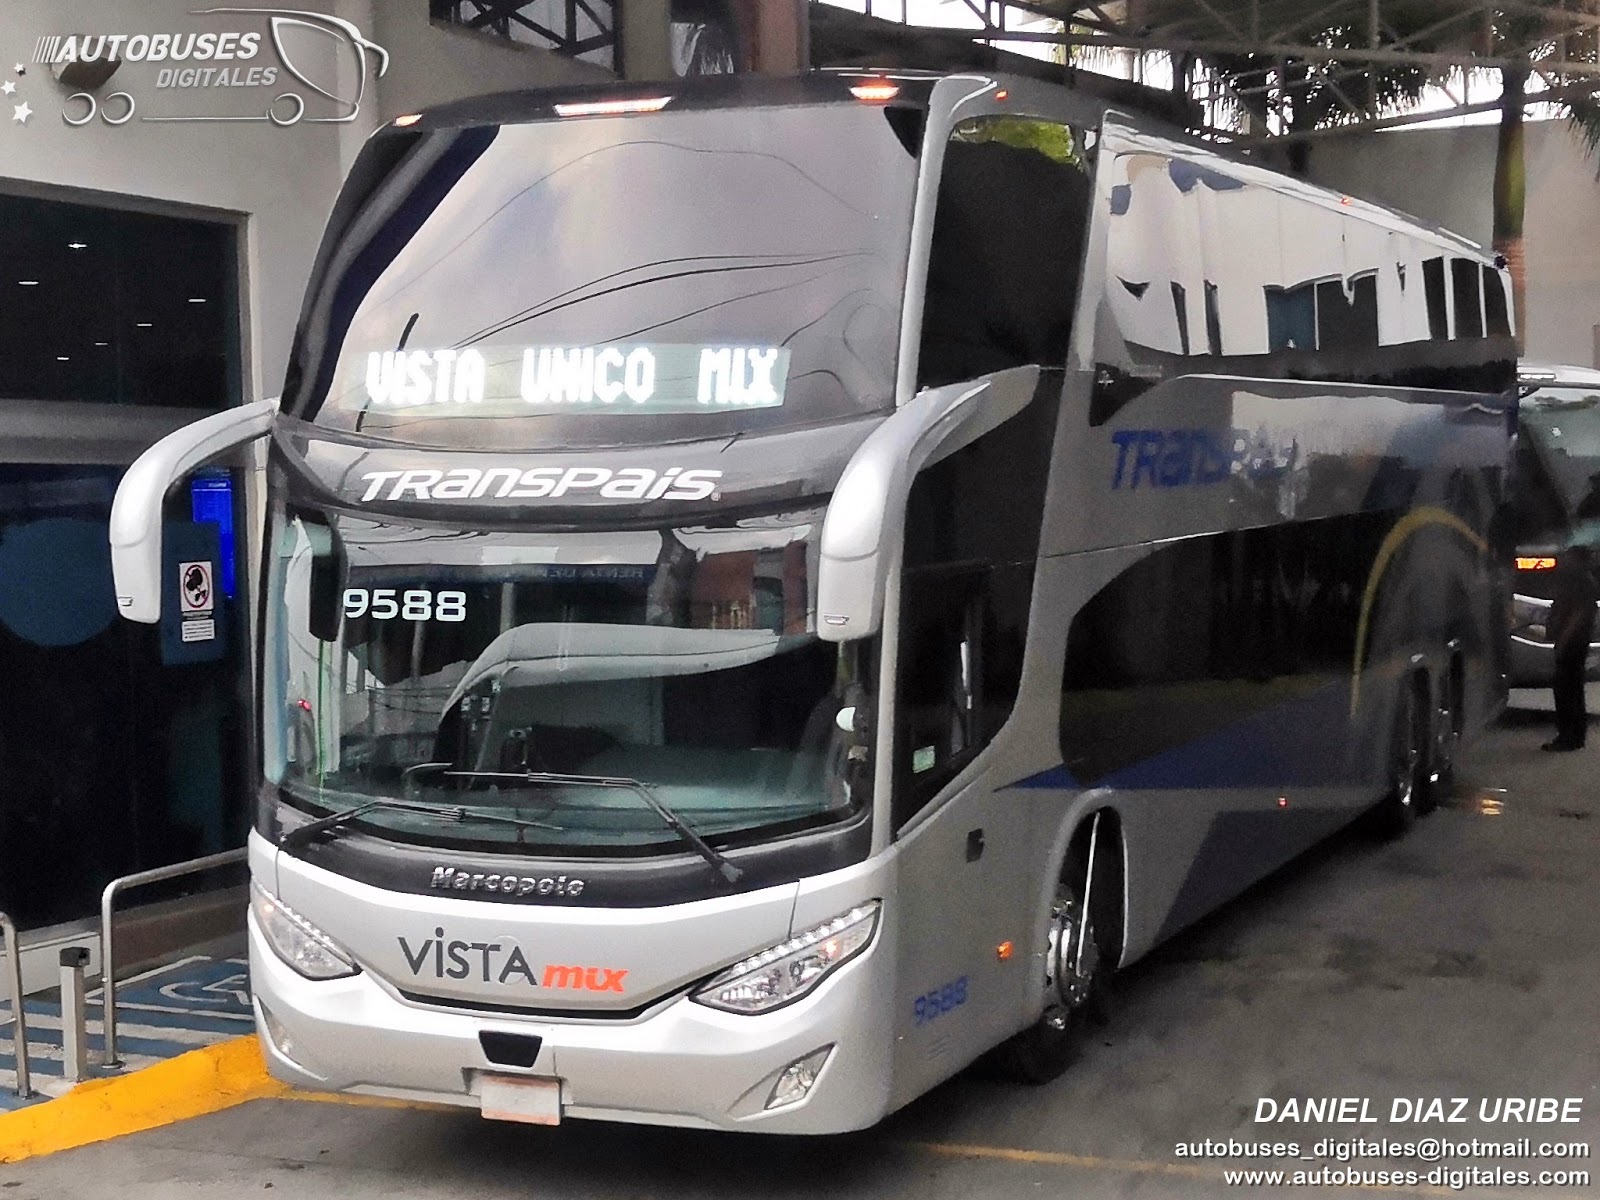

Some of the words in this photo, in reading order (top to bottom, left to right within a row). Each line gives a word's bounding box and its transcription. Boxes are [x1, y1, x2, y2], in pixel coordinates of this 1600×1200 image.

[697, 347, 779, 404] MIX
[343, 588, 467, 622] 9588
[431, 866, 584, 896] Marcopolo
[542, 964, 629, 992] mix
